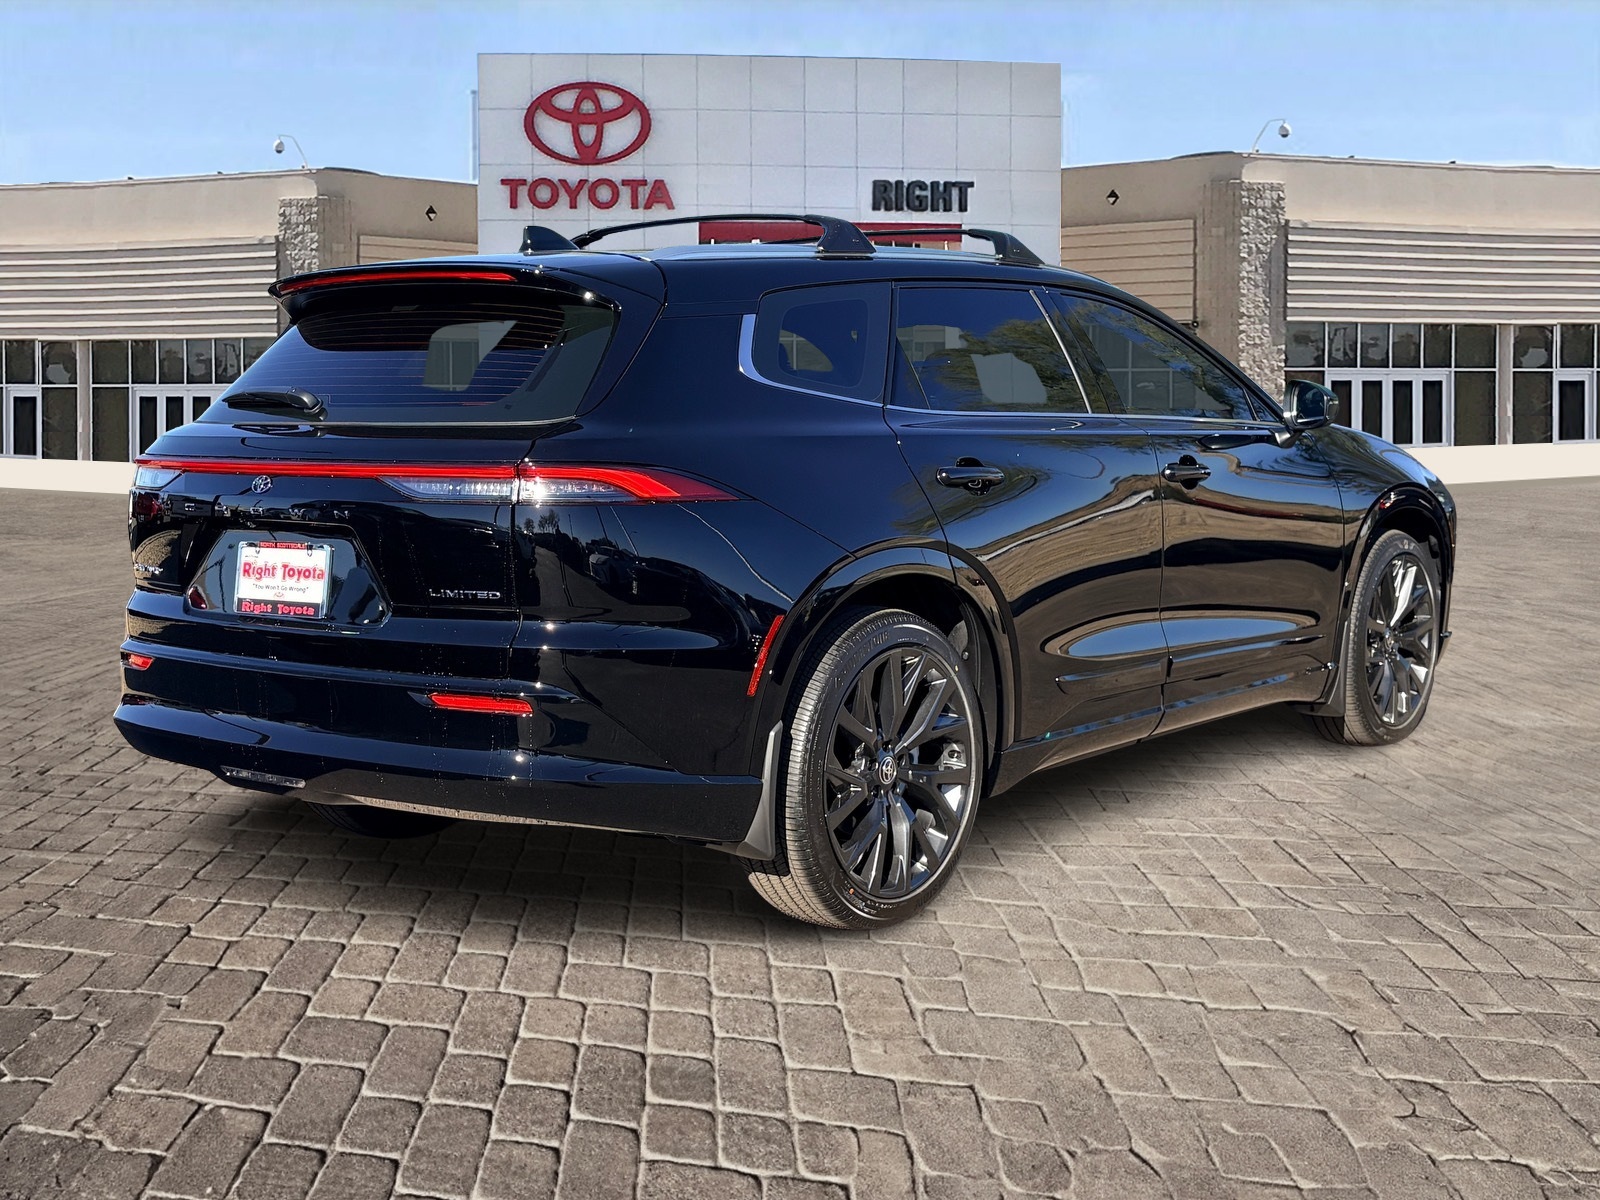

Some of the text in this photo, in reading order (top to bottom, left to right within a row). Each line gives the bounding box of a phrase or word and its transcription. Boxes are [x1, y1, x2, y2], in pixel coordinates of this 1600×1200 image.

[500, 178, 675, 210] TOYOTA
[870, 178, 975, 213] RIGHT
[242, 561, 325, 582] Right Toyota
[428, 588, 501, 599] LIMITED
[241, 601, 315, 616] Right Toyota
